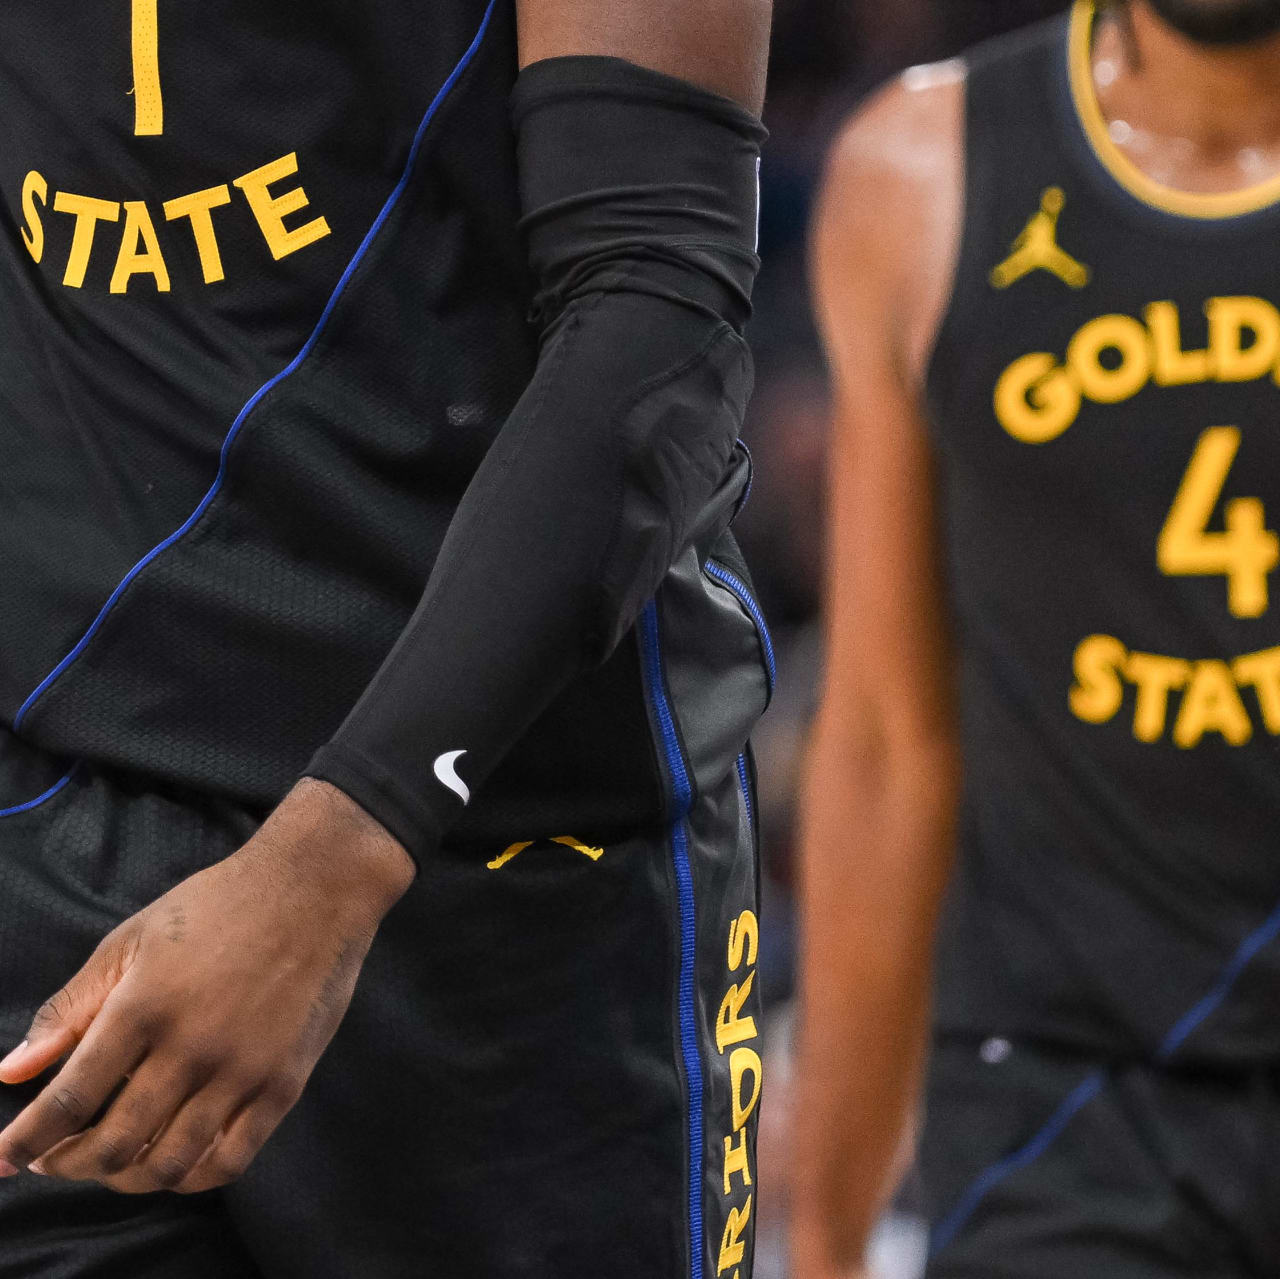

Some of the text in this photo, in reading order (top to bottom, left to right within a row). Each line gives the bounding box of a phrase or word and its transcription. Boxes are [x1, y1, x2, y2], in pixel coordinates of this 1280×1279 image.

[21, 152, 331, 294] STATE
[1157, 426, 1279, 618] 4
[716, 909, 763, 1279] RIORS
